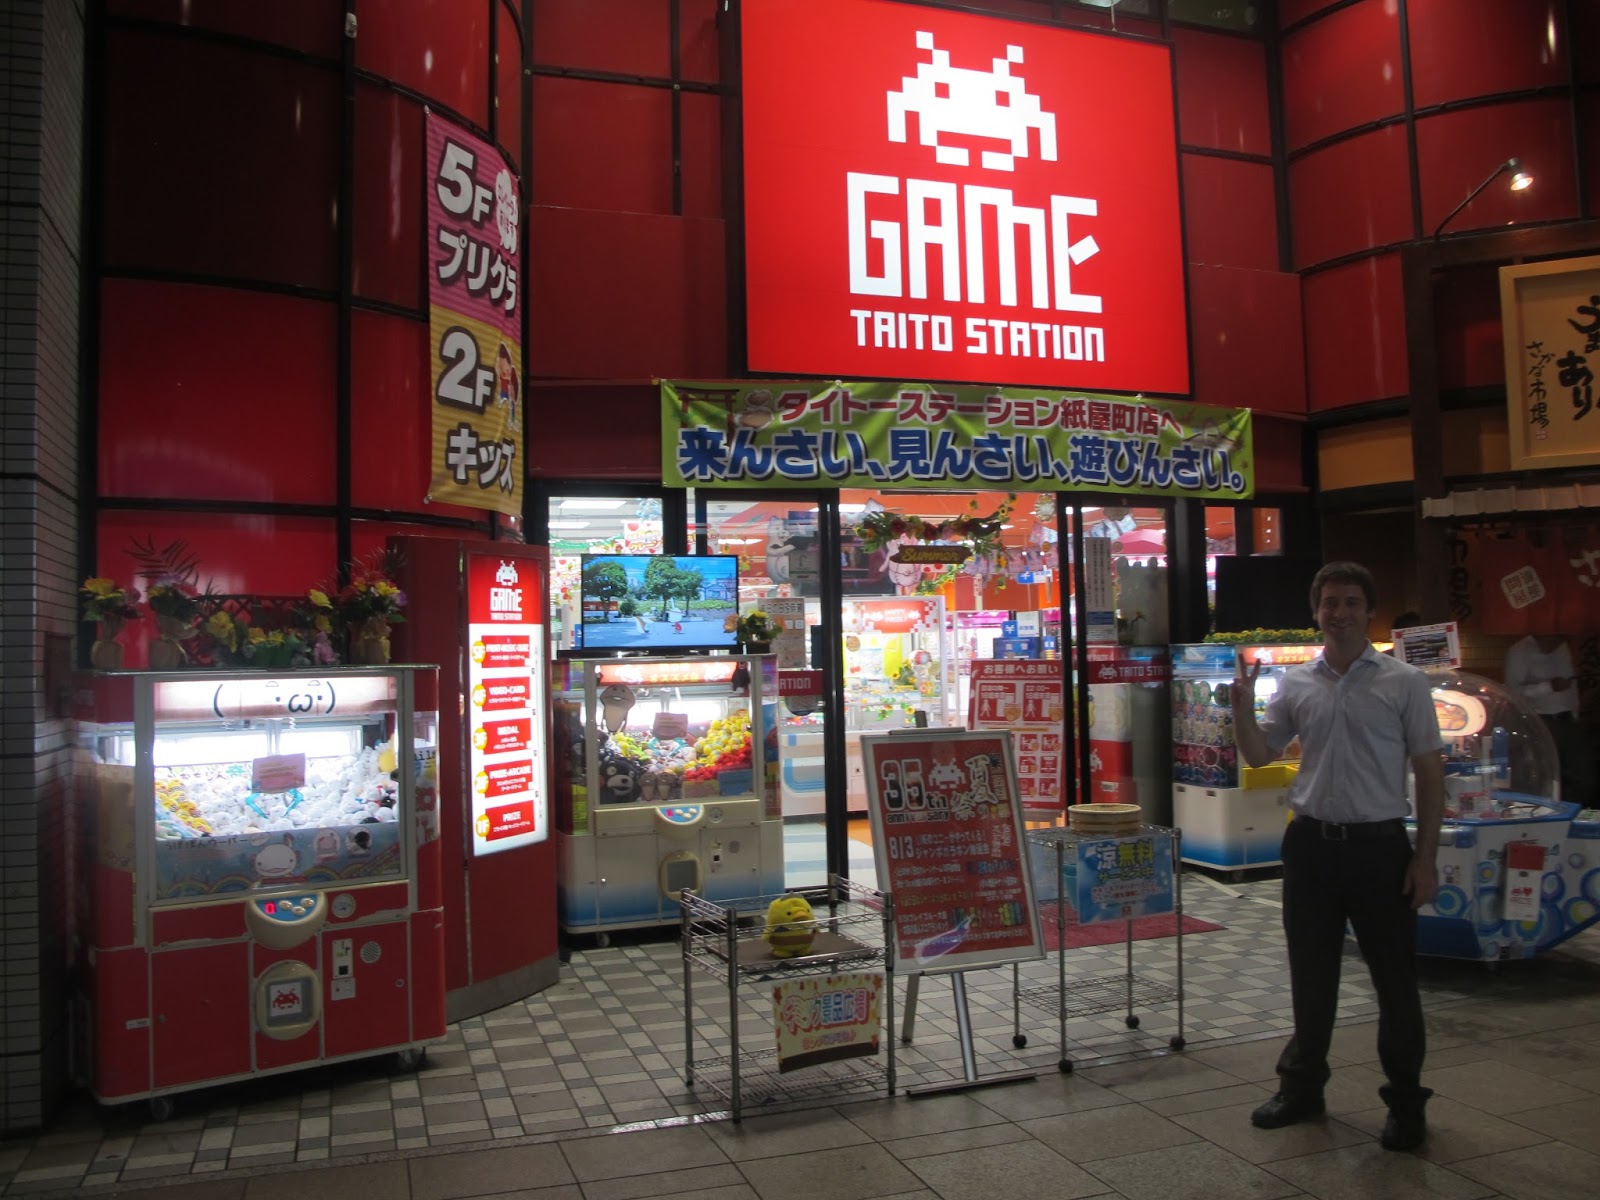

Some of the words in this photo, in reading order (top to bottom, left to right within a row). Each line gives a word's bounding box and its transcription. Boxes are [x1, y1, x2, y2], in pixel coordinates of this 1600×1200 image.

[437, 142, 493, 223] 5F
[847, 172, 1102, 313] GAME
[438, 231, 518, 311] プリクラ
[850, 309, 953, 351] TAITO
[966, 317, 1105, 362] STATION
[437, 330, 494, 408] 2F
[777, 390, 1184, 436] タイトーステーション紙屋町店へ
[447, 427, 516, 492] キッズ
[901, 547, 961, 564] Summer
[490, 587, 523, 612] GAME
[983, 664, 1059, 675] お客様へお願い
[1118, 665, 1145, 677] TAITO
[497, 725, 520, 736] MEDAL
[502, 811, 522, 822] PRIZE
